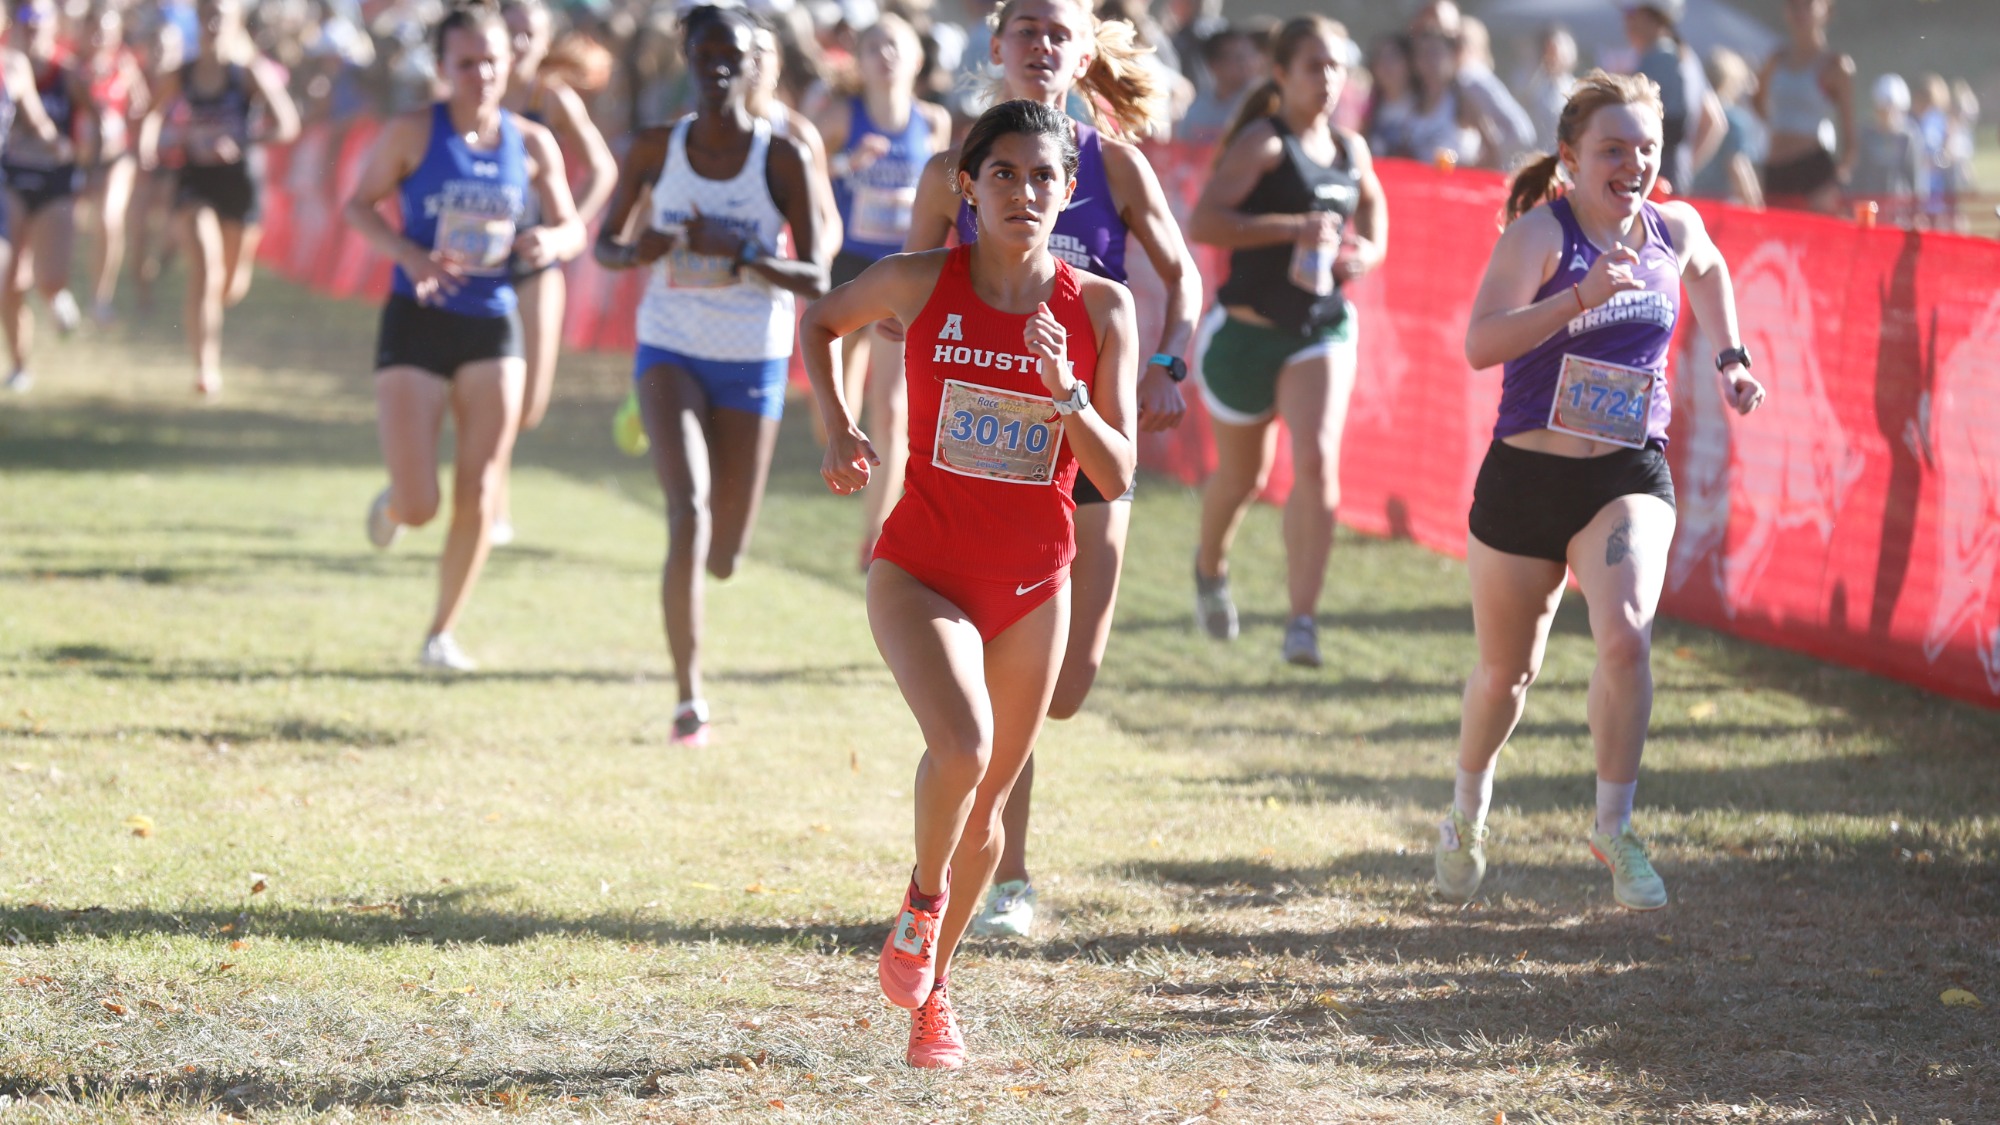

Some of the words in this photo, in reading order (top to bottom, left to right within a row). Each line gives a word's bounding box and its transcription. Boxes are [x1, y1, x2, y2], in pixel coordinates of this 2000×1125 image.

[938, 313, 964, 341] A
[1568, 381, 1645, 422] 1724
[950, 410, 1050, 454] 3010
